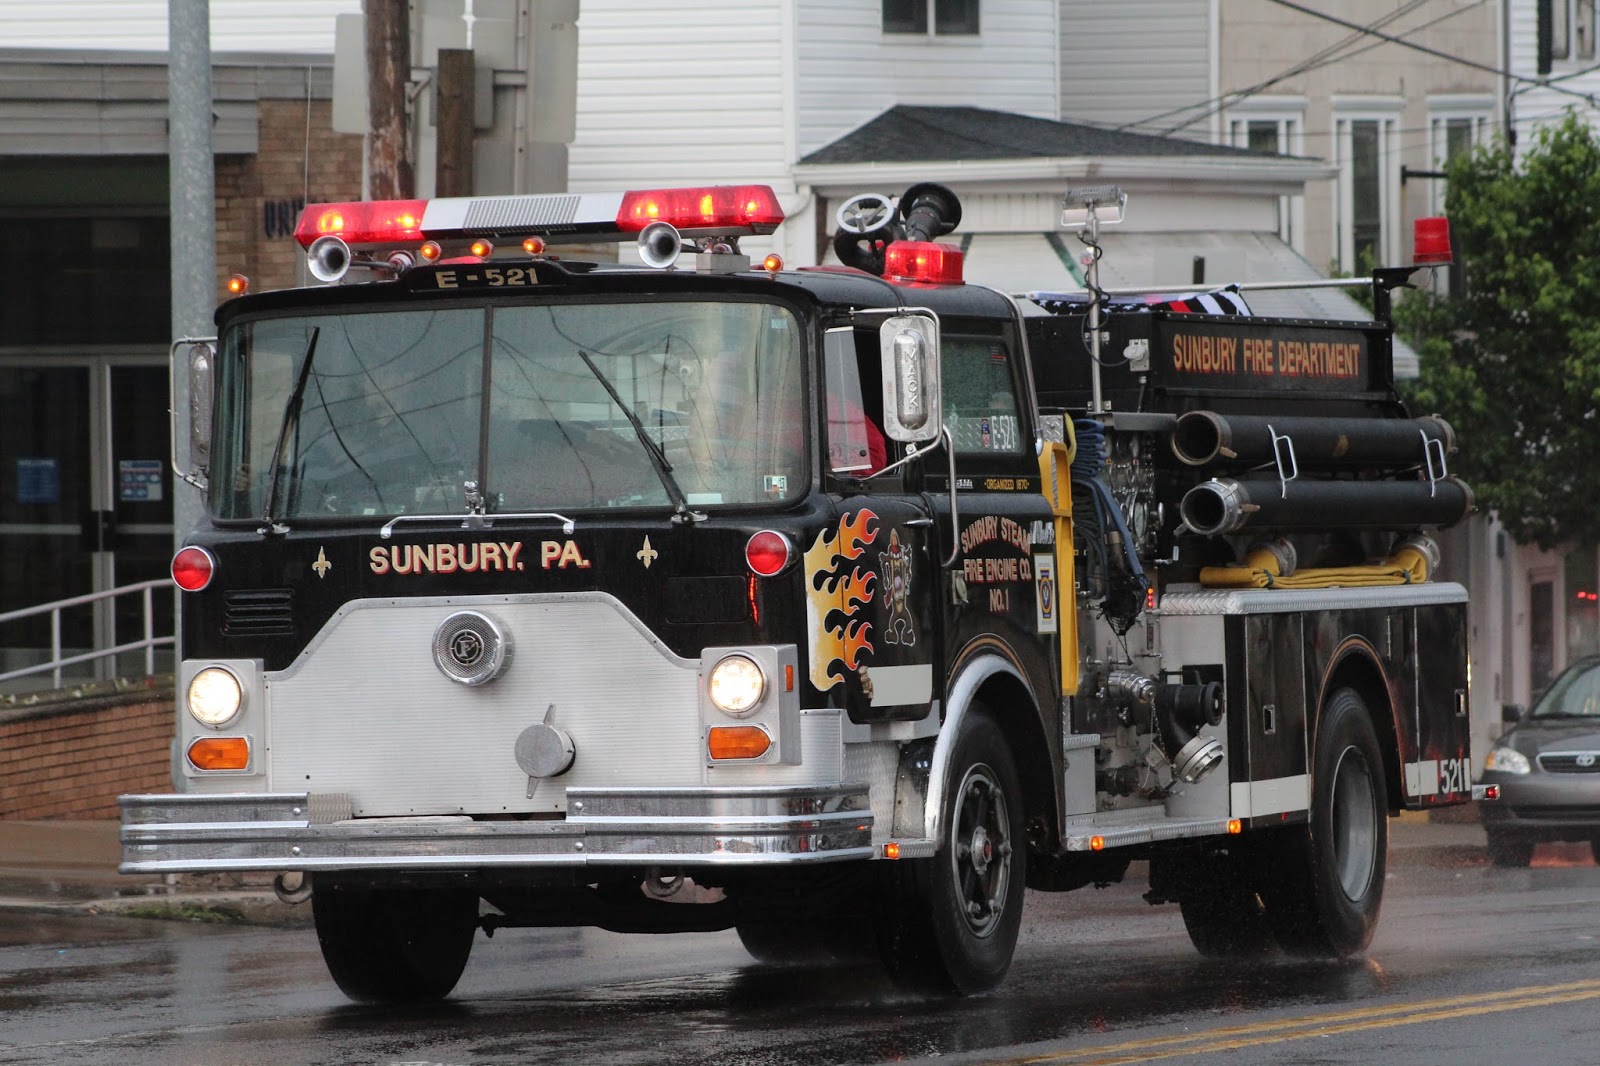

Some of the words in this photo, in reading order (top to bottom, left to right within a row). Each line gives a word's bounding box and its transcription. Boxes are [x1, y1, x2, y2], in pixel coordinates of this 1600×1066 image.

[1173, 333, 1238, 375] SUNBURY
[1243, 338, 1275, 376] FIRE
[1278, 340, 1361, 379] DEPARTMENT
[986, 479, 1015, 490] ORGANIZED
[961, 515, 998, 554] SUNBURY
[541, 539, 592, 570] PA.
[963, 558, 984, 584] FIRE
[985, 558, 1018, 583] ENGINE
[1440, 758, 1464, 794] 521
